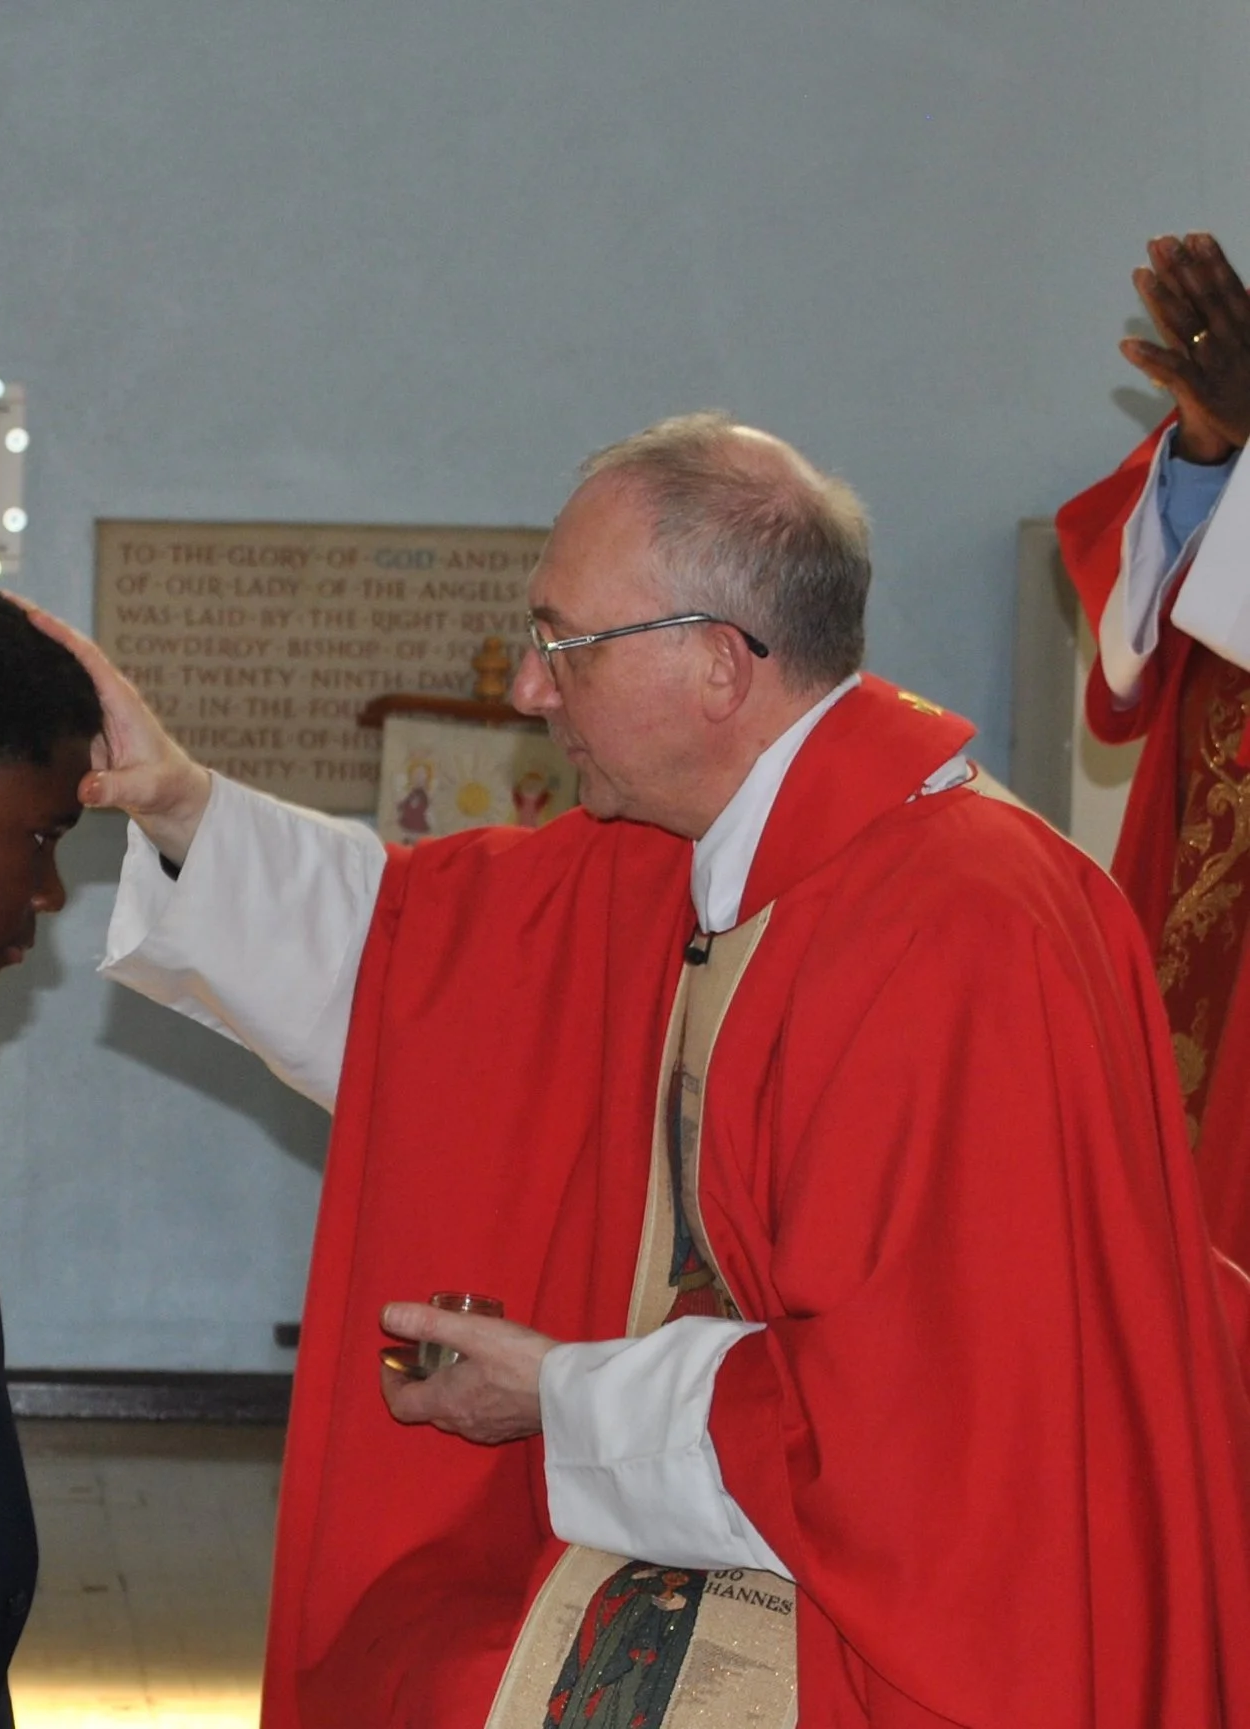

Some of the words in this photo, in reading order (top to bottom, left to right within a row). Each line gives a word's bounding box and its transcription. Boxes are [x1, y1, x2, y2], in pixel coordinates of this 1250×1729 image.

[120, 543, 155, 565] TO
[170, 545, 214, 566] THE
[227, 545, 310, 568] GLORY
[326, 547, 359, 568] OF
[373, 547, 434, 570] GOD
[447, 549, 509, 571] AND
[116, 573, 148, 596] OF
[166, 575, 223, 598] OUR
[234, 576, 299, 597] LADY
[318, 577, 347, 597] OF
[362, 578, 405, 599] THE
[417, 580, 520, 603] ANGELS
[116, 604, 170, 625] WAS
[184, 606, 247, 627] LAID
[261, 607, 292, 628] BY
[310, 608, 357, 629] THE
[371, 611, 448, 633] RIGHT
[461, 612, 531, 633] REVE
[287, 638, 380, 660] BISHOP
[396, 640, 428, 660] OF
[182, 665, 297, 688] TWENTY
[311, 668, 402, 690] NINTH
[419, 670, 468, 691] DAY
[199, 696, 231, 718] IN
[248, 697, 296, 719] THE
[298, 729, 329, 750] OF
[704, 1581, 794, 1616] HANNES
